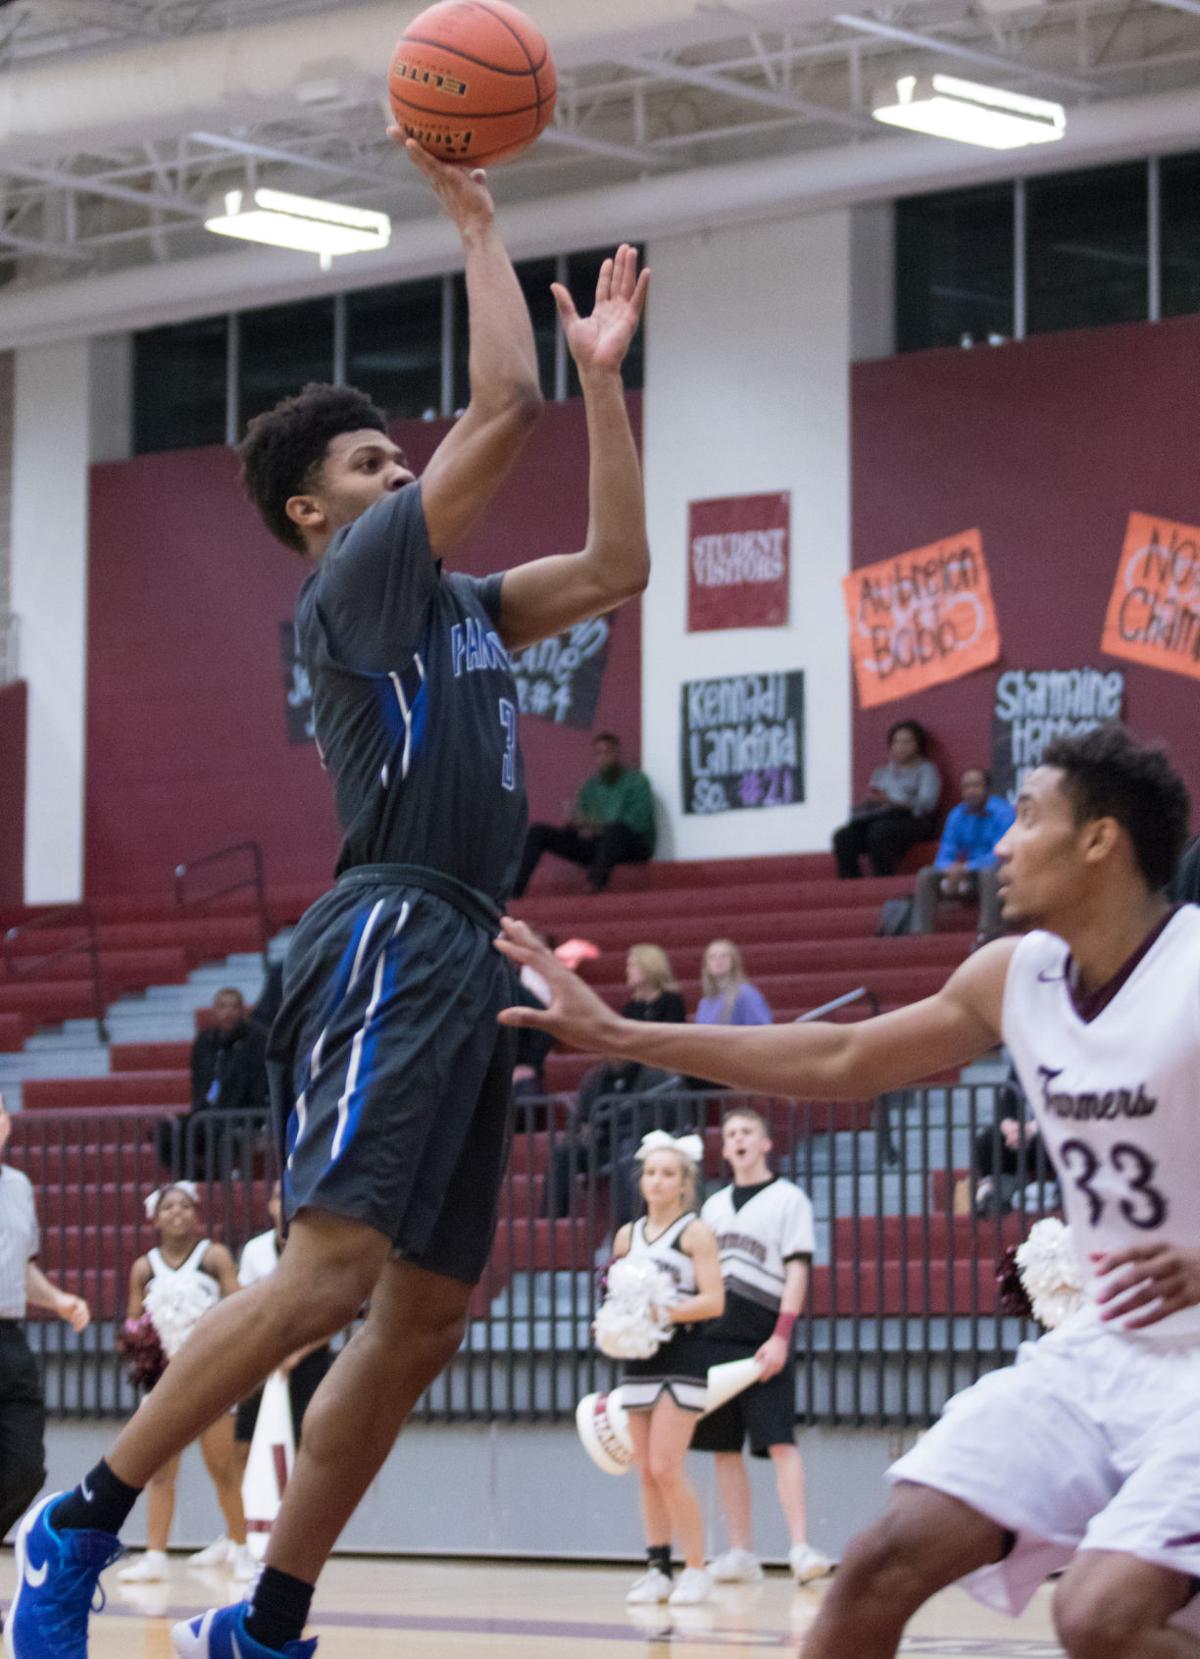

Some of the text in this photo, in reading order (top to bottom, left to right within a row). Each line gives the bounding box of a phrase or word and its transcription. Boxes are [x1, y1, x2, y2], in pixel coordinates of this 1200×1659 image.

[394, 63, 467, 97] ELITE
[692, 527, 785, 562] STUDENT
[1059, 1138, 1168, 1231] 33
